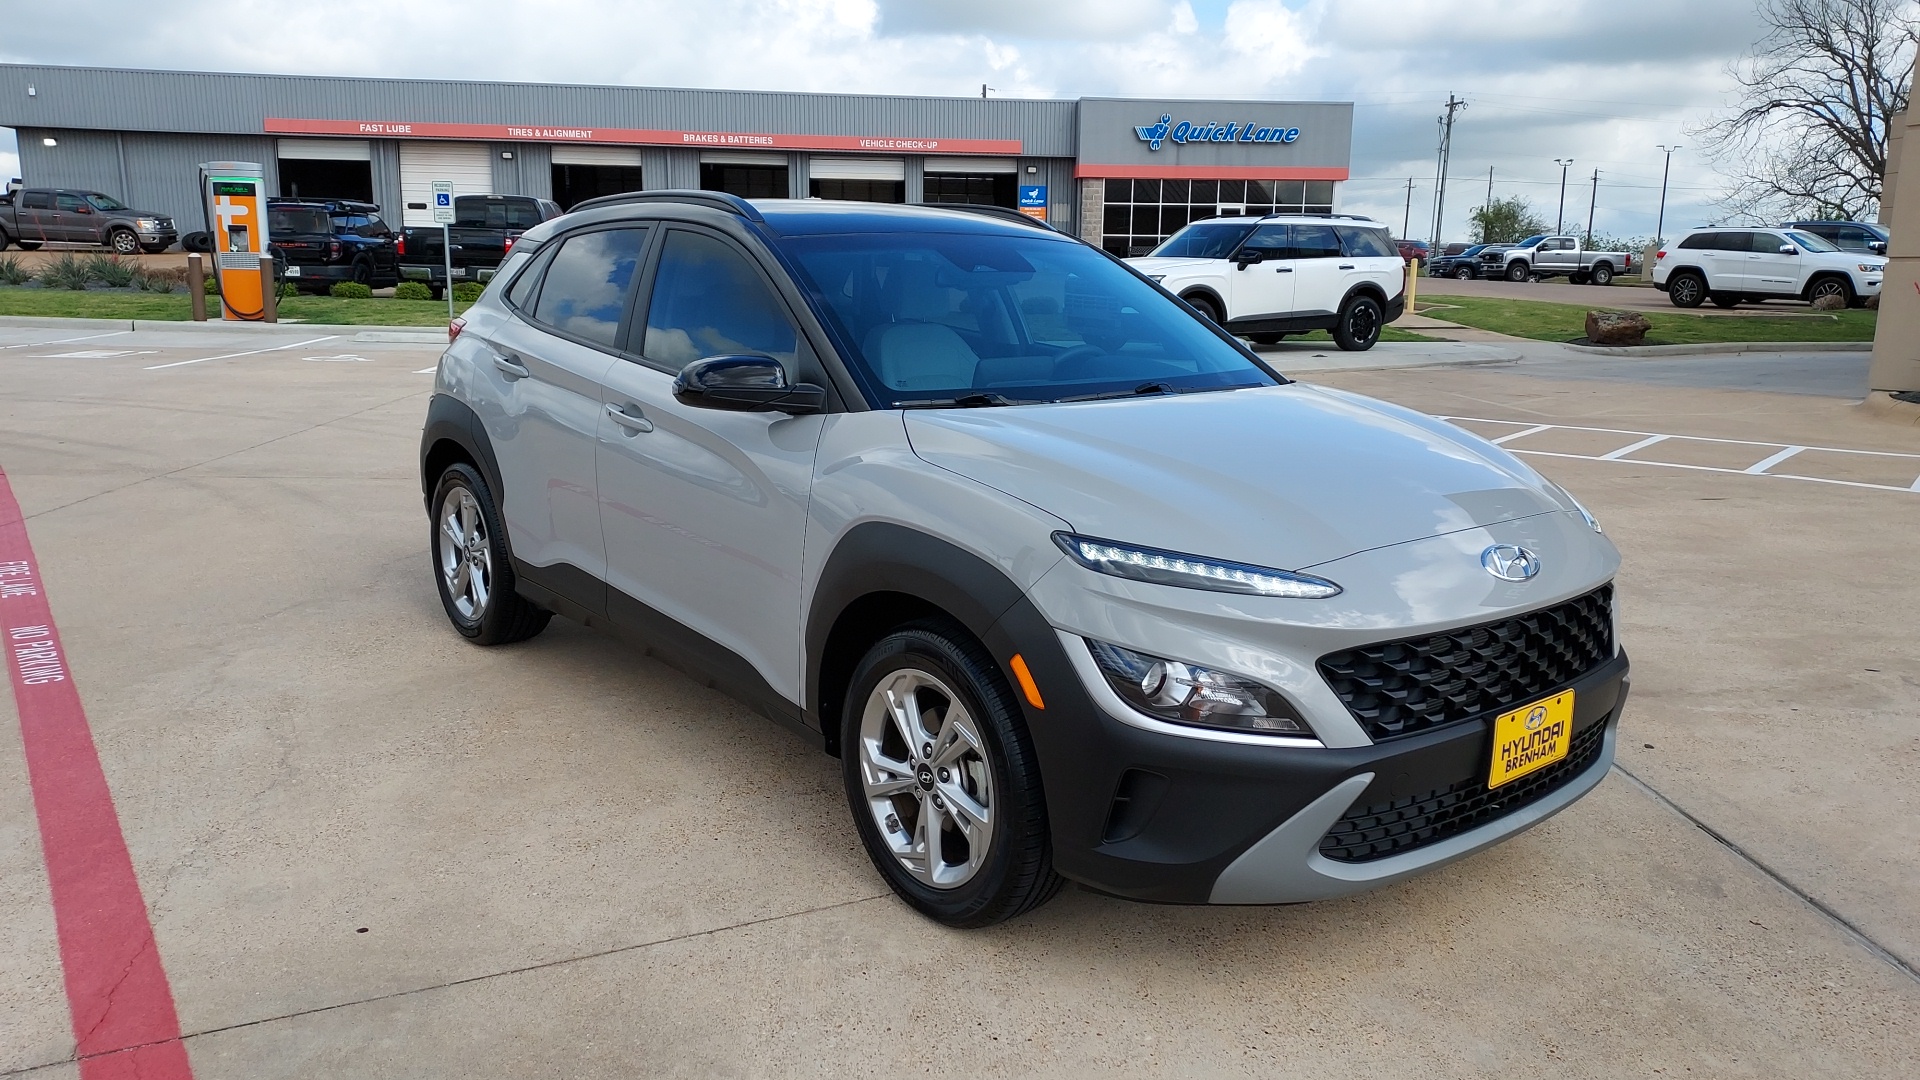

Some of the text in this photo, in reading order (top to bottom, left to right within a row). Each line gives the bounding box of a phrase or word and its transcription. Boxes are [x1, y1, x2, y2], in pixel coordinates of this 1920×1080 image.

[359, 123, 412, 133] FAST LUBE
[507, 127, 593, 139] TIRES & ALIGNMENT
[1171, 120, 1300, 143] Quick Lane
[683, 133, 773, 145] BRAKES & BATTERIES
[859, 139, 938, 149] VEHICLE CHECK-UP
[0, 560, 65, 685] FIRE LANE NO PARKING
[1501, 720, 1564, 761] HYUNDAI
[1505, 740, 1557, 773] BRENHAM
